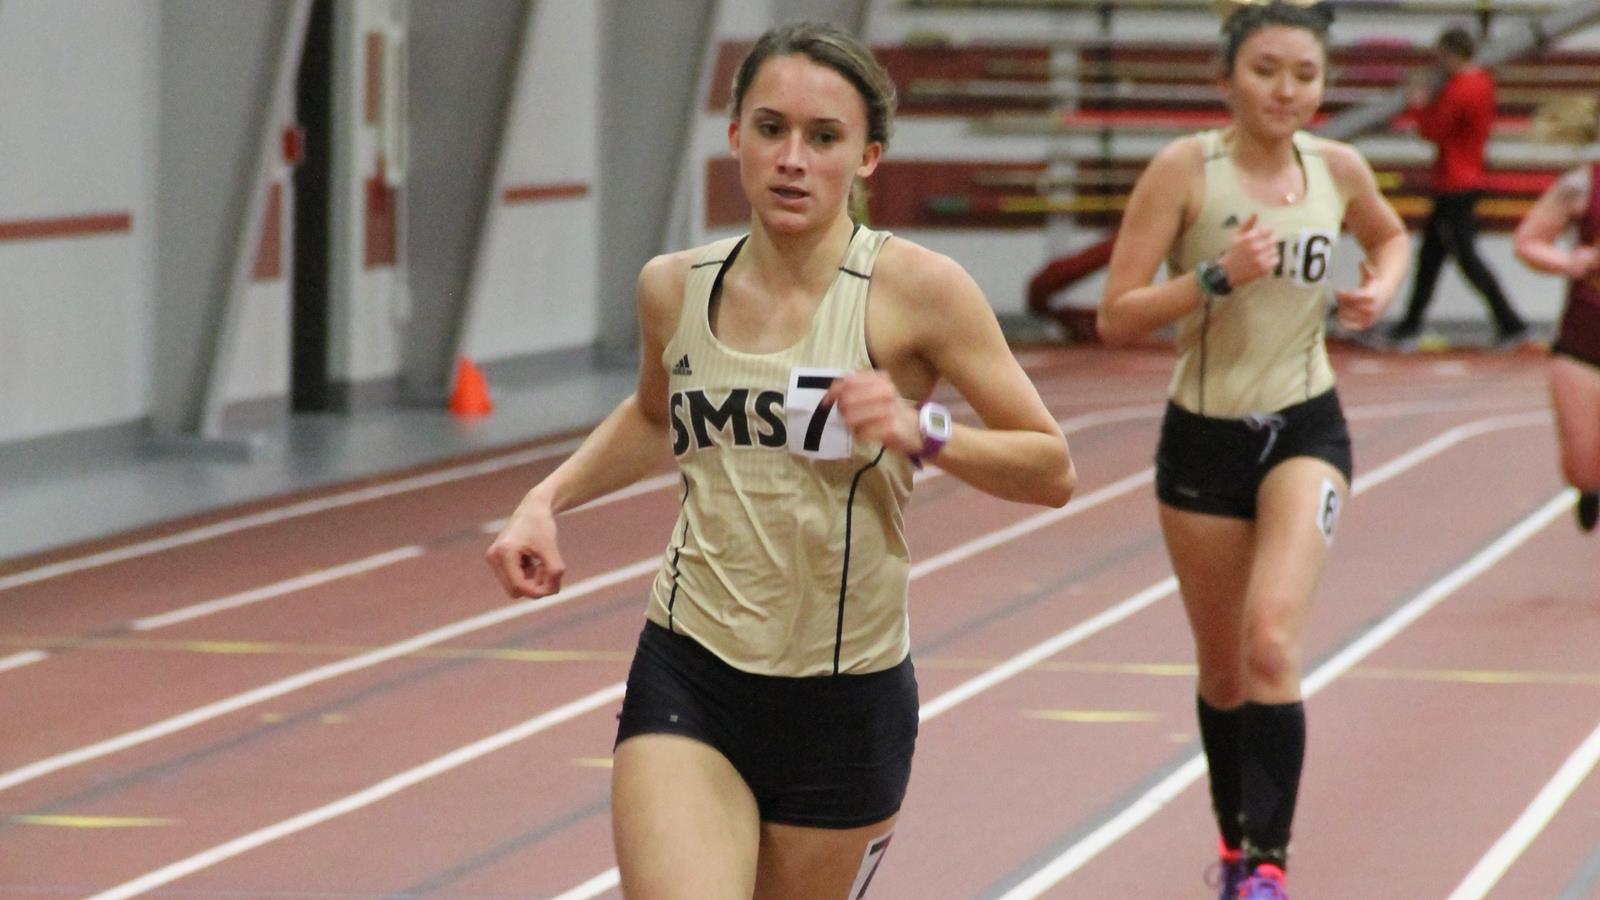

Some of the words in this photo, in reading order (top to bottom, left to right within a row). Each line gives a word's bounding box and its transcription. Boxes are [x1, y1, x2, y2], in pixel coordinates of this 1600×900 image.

[1303, 235, 1330, 283] 6
[670, 388, 787, 456] SMS
[797, 375, 843, 452] 7
